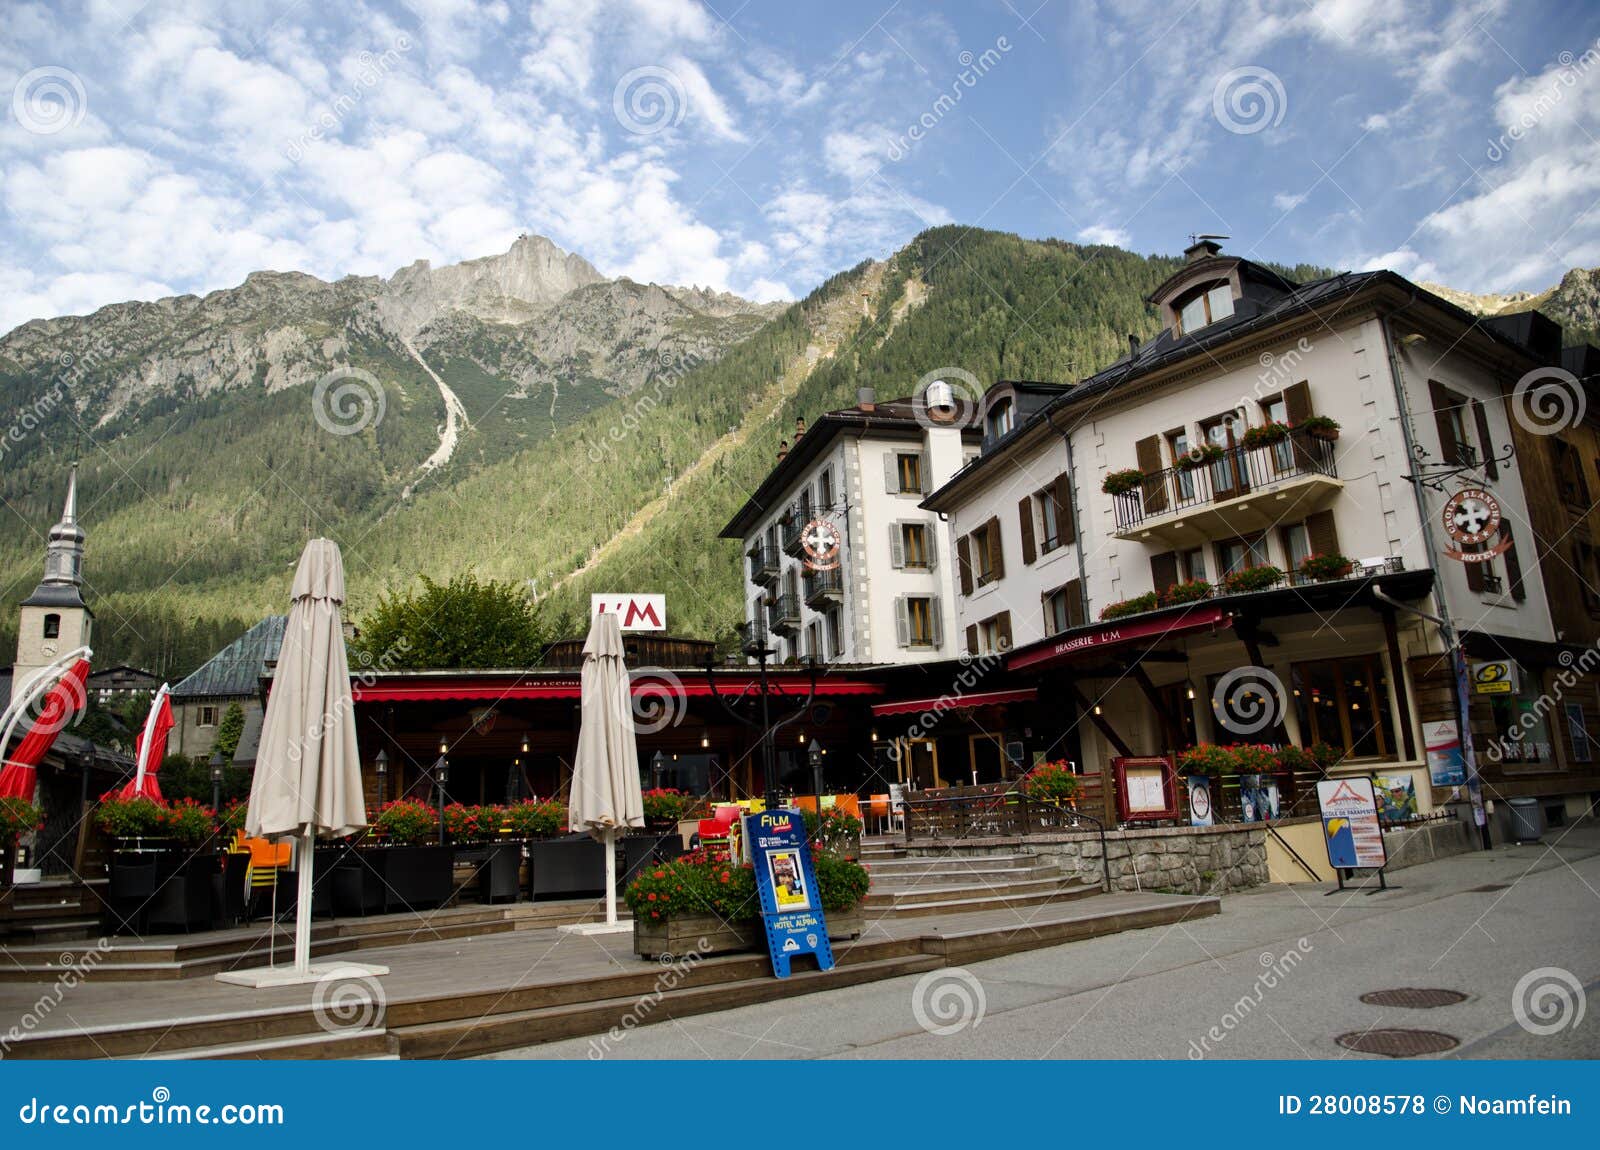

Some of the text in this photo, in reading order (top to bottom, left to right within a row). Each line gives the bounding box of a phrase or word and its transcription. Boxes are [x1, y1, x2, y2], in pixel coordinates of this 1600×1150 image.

[1444, 491, 1500, 534] CROIX BLANCHE
[1461, 549, 1497, 561] HOTEL
[1055, 630, 1121, 654] BRASSERIE L'M
[761, 815, 789, 828] FILM
[774, 918, 817, 930] HOTEL ALPINA
